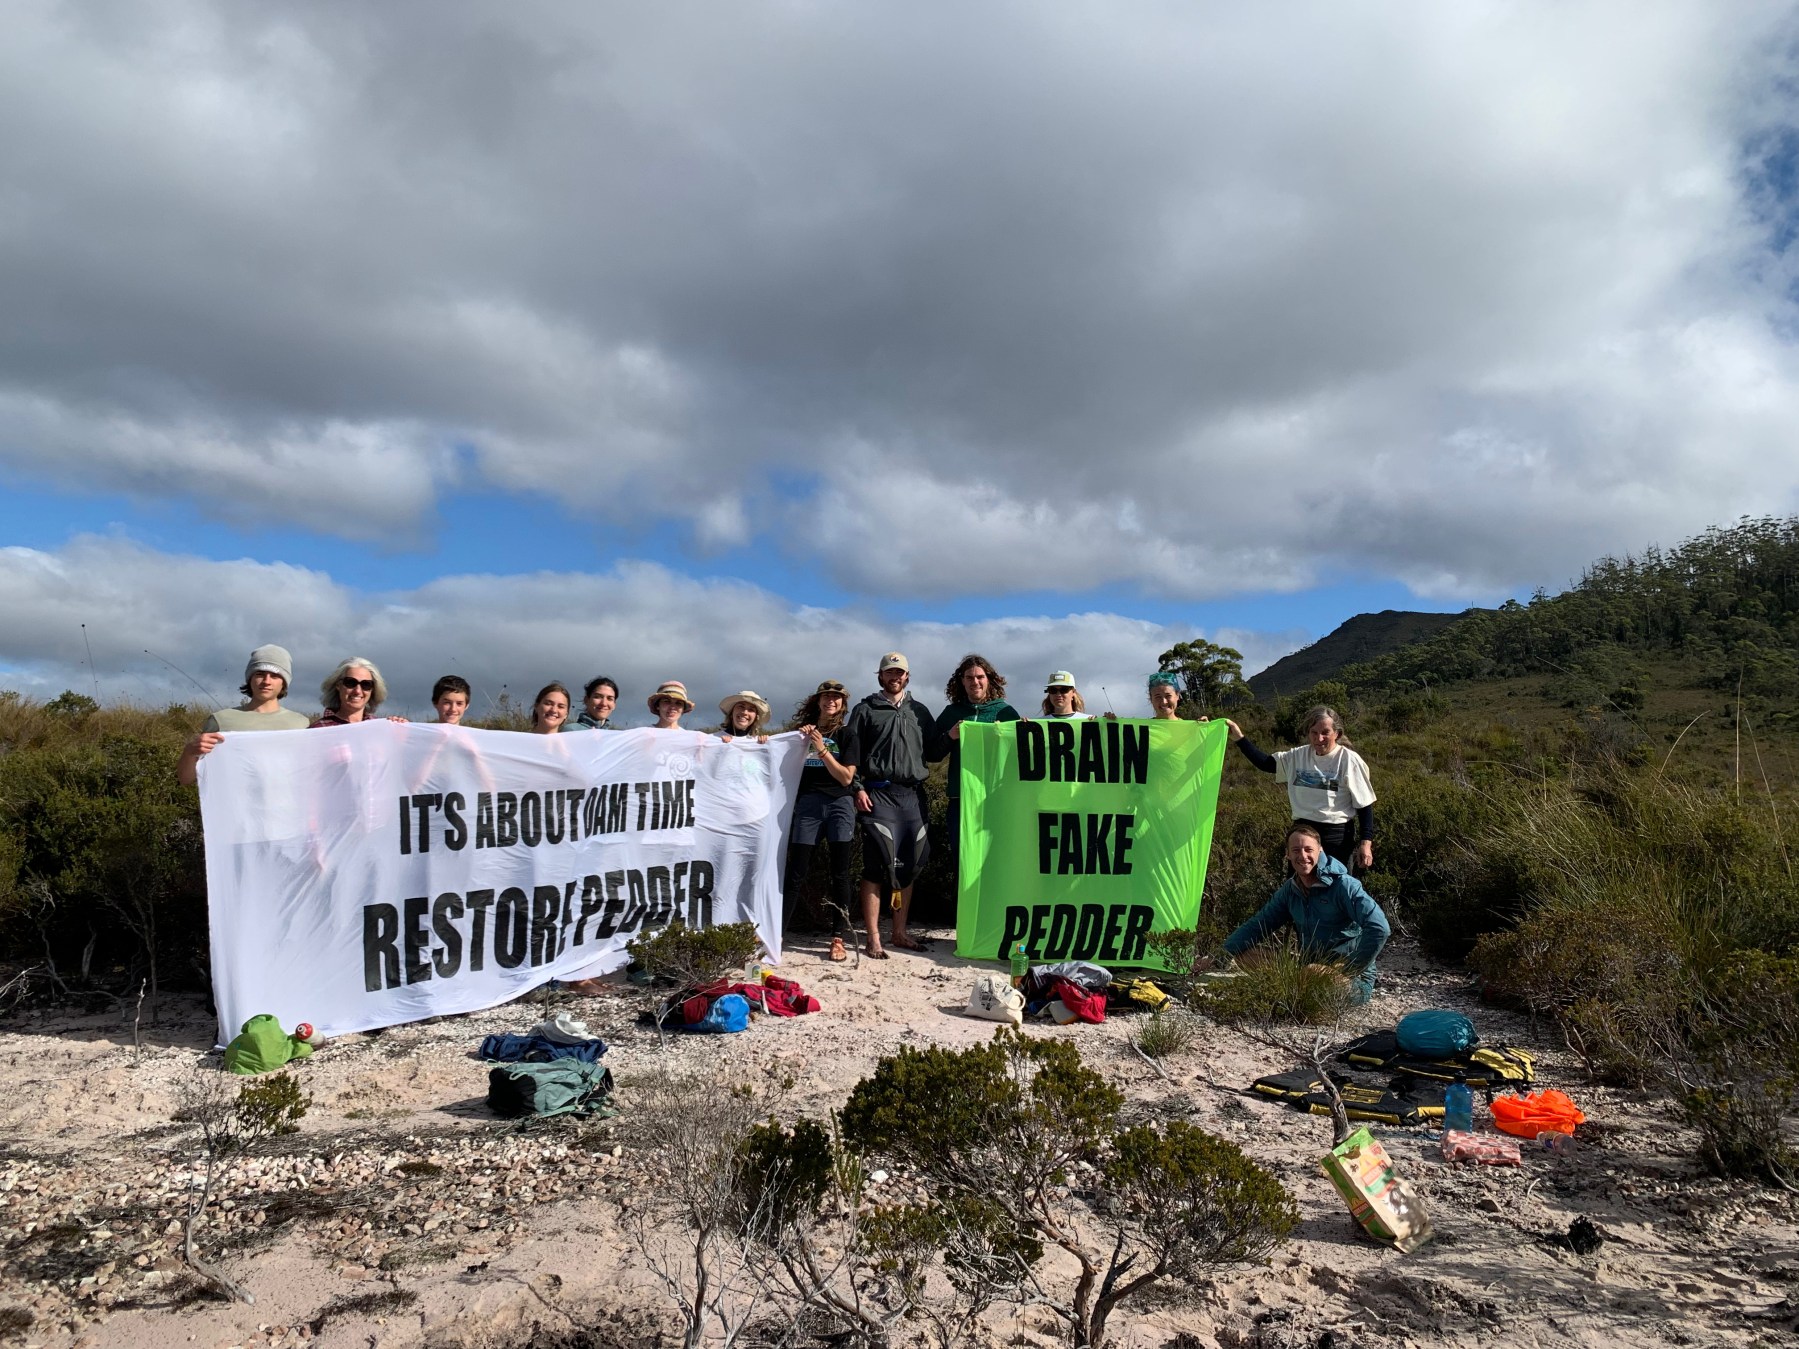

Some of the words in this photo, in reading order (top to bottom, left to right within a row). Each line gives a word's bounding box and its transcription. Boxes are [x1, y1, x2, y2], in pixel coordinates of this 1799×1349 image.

[1015, 721, 1150, 784] DRAIN
[399, 791, 467, 855] IT'S
[475, 788, 585, 849] ABOUT
[583, 782, 628, 839] DAM
[634, 779, 696, 831] TIME
[1037, 812, 1135, 875] FAKE
[572, 860, 714, 947] PEDDER
[997, 904, 1155, 961] PEDDER
